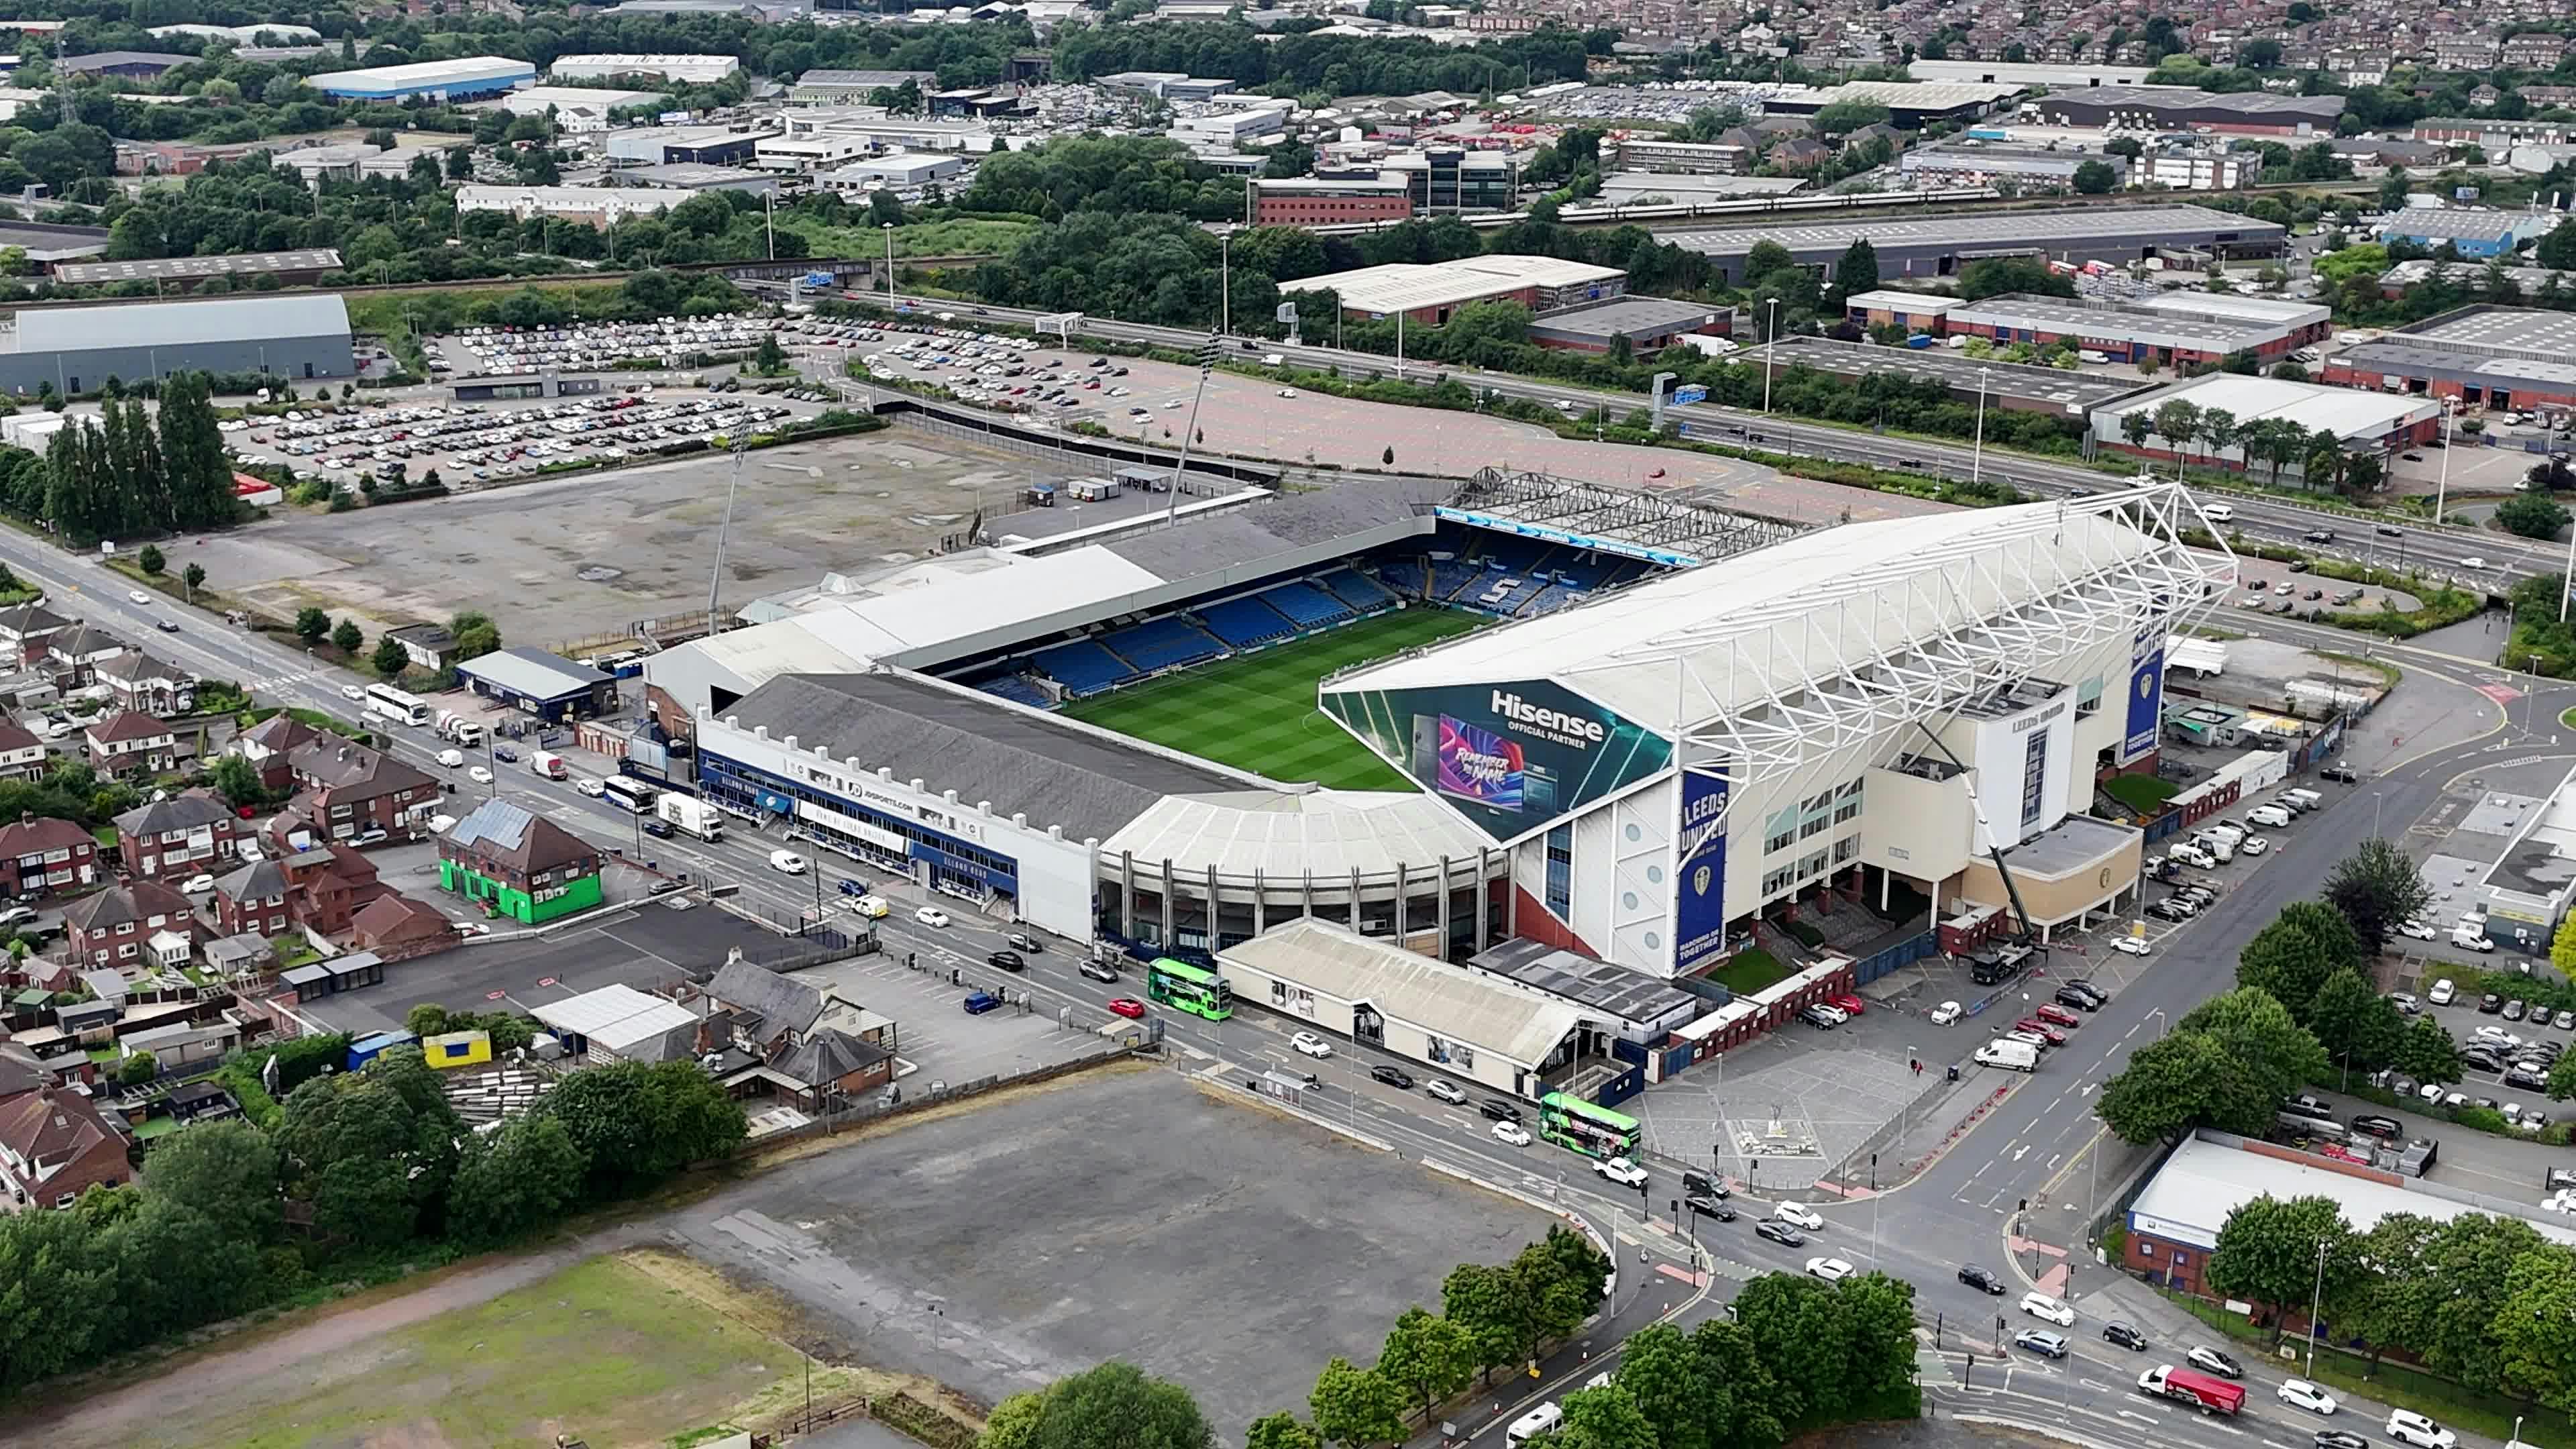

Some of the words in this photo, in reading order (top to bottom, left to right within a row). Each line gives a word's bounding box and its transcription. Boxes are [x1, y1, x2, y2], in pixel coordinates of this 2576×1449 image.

[1491, 689, 1604, 742] Hisense
[1507, 720, 1546, 739] OFFICIAL
[1547, 731, 1586, 750] PARTNER
[1684, 792, 1726, 826] LEEDS
[1681, 816, 1726, 852] UNITED
[1679, 936, 1719, 961] TOGETHER
